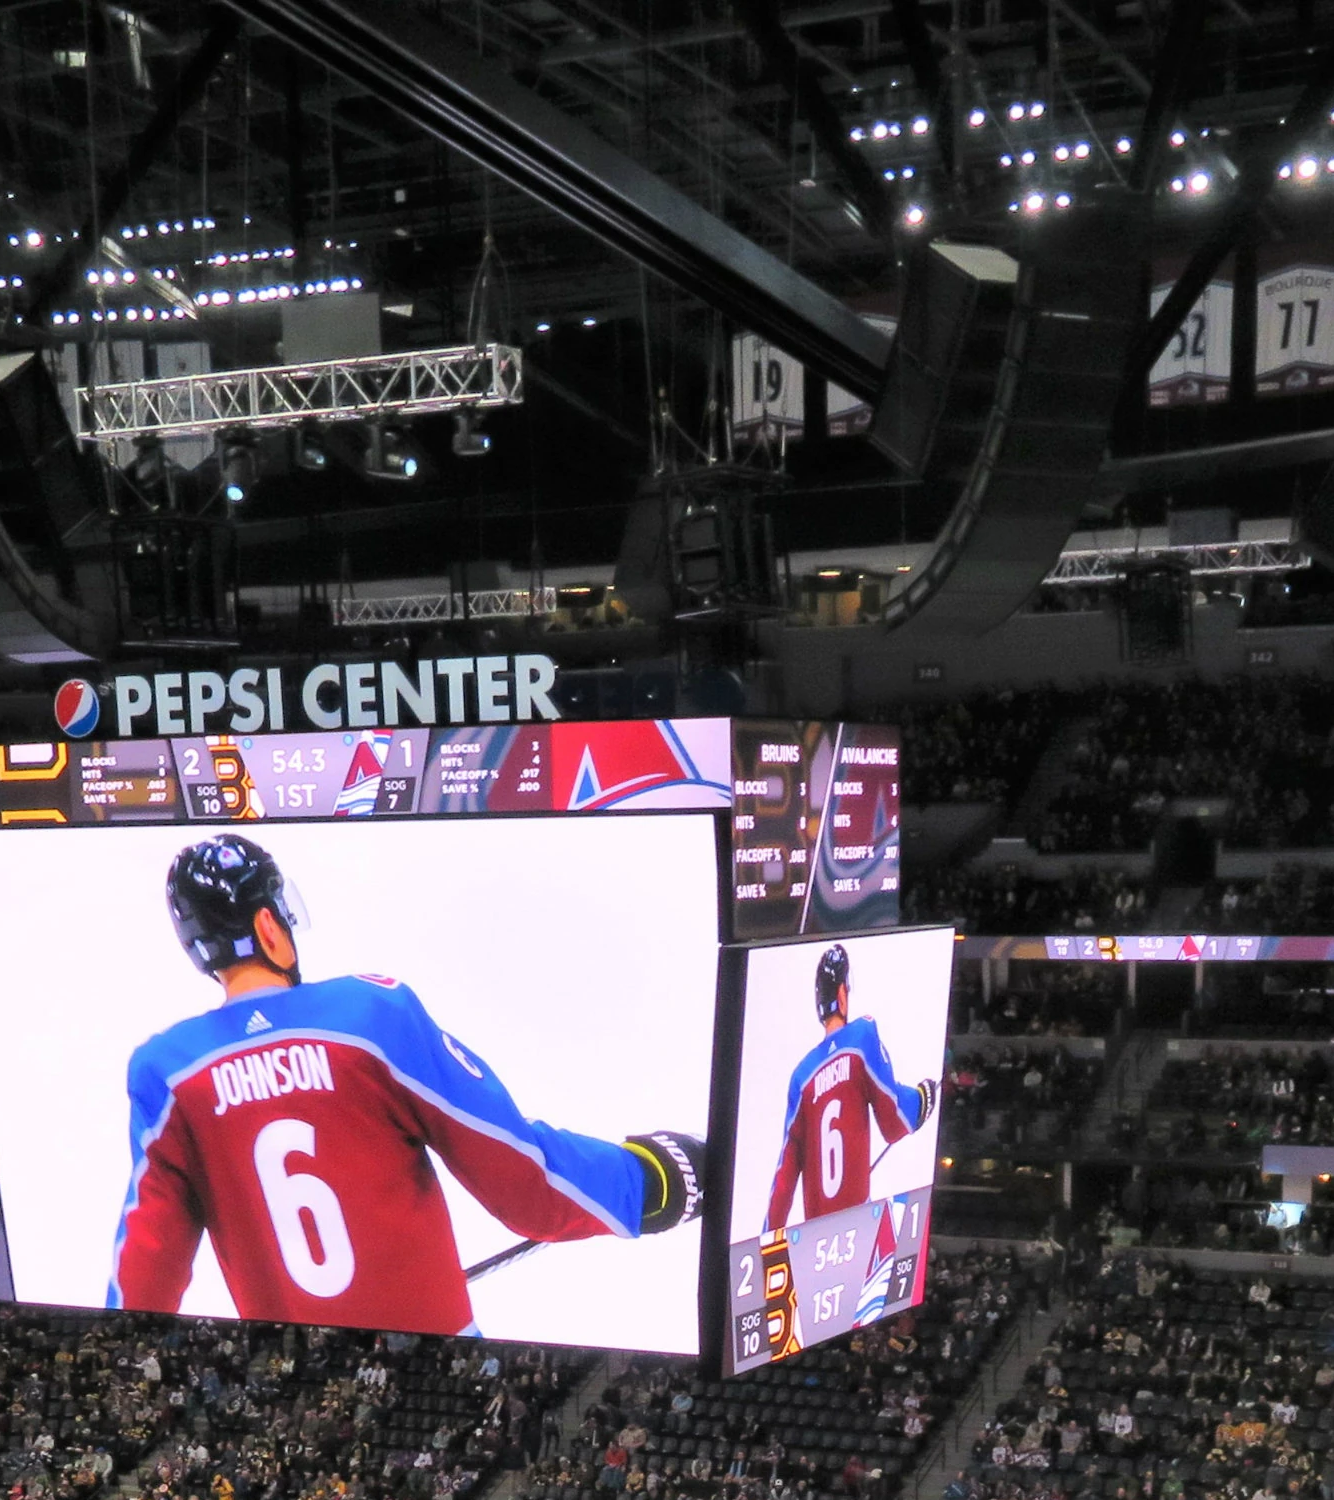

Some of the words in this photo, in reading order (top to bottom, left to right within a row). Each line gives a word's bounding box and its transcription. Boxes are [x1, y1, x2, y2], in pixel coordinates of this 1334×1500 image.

[1266, 276, 1333, 296] BOURQUE
[1279, 299, 1319, 349] 77
[753, 360, 782, 402] 19
[1250, 652, 1274, 664] 342
[115, 667, 284, 737] PEPSI
[302, 654, 562, 729] CENTER
[399, 739, 413, 768] 1
[441, 743, 480, 755] BLOCKS
[532, 741, 539, 751] 3
[762, 744, 799, 762] BRUINS
[841, 747, 898, 766] AVALANCHE
[81, 757, 117, 767] BLOCKS
[183, 748, 200, 776] 2
[272, 747, 326, 774] 54.3
[441, 757, 463, 768] HITS
[532, 755, 540, 764] 4
[82, 769, 102, 779] HITS
[441, 769, 488, 781] FACEOFF
[490, 769, 499, 780] %
[520, 768, 540, 779] .917
[83, 781, 124, 792] FACEOFF
[125, 781, 133, 790] %
[197, 786, 218, 797] SOG
[384, 780, 406, 792] SOG
[442, 783, 468, 795] SAVE
[470, 783, 478, 793] %
[518, 782, 540, 792] .800
[735, 780, 768, 796] BLOCKS
[800, 783, 806, 796] 3
[834, 782, 863, 796] BLOCKS
[892, 783, 898, 796] 3
[84, 794, 107, 803] SAVE
[108, 793, 116, 803] %
[277, 783, 316, 809] 1ST
[387, 793, 399, 810] 7
[203, 799, 221, 815] 10
[736, 815, 754, 830] HITS
[834, 814, 851, 828] HITS
[891, 815, 898, 827] 4
[736, 848, 774, 863] FACEOFF
[775, 848, 782, 862] %
[834, 847, 866, 860] FACEOFF
[867, 846, 874, 859] %
[737, 885, 759, 898] SAVE
[759, 884, 766, 897] %
[834, 880, 853, 893] SAVE
[854, 879, 860, 891] %
[1084, 940, 1094, 955] 2
[1209, 940, 1216, 955] 1
[211, 1044, 335, 1117] JOHNSON
[813, 1056, 850, 1104] JOHNSON
[820, 1099, 843, 1199] 6
[254, 1118, 356, 1298] 6
[911, 1203, 919, 1239] 1
[814, 1229, 857, 1272] 54.3
[737, 1255, 754, 1297] 2
[897, 1259, 912, 1276] SOG
[898, 1277, 907, 1299] 7
[813, 1284, 845, 1324] 1ST
[741, 1312, 761, 1332] SOG
[743, 1331, 760, 1357] 10
